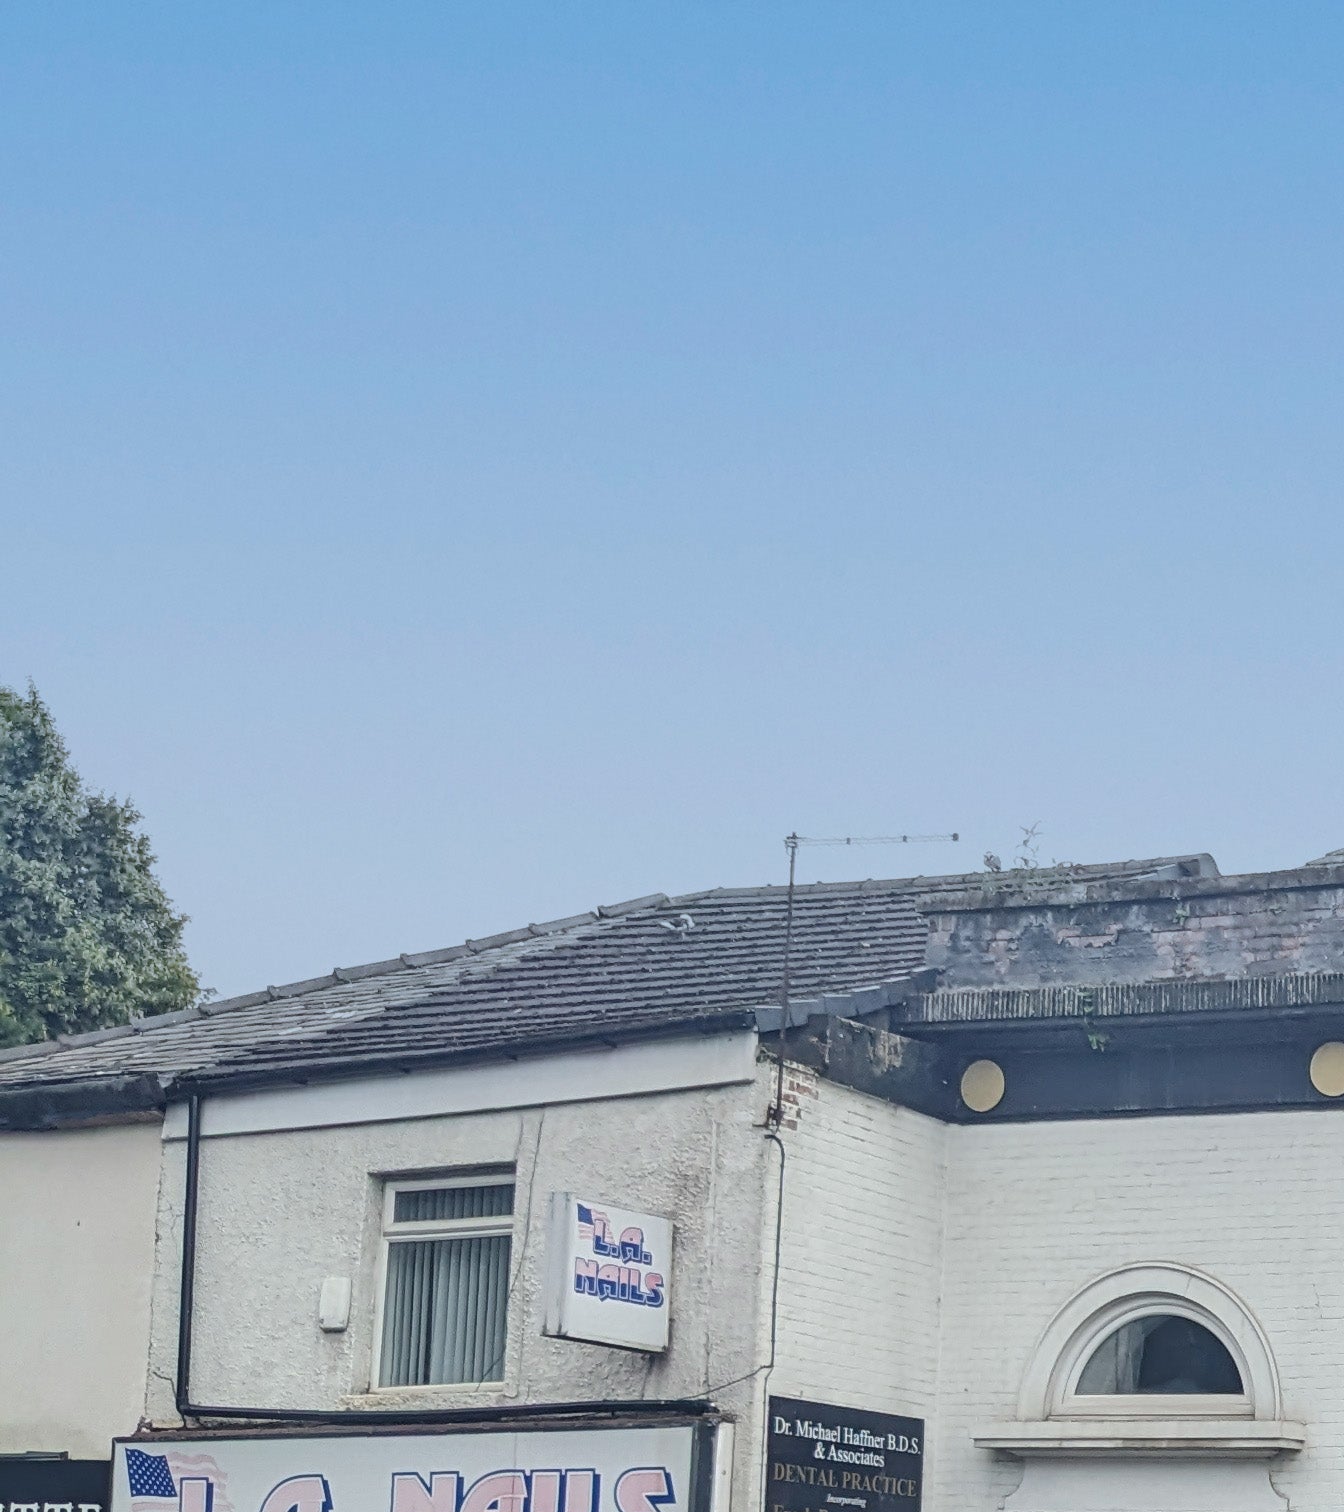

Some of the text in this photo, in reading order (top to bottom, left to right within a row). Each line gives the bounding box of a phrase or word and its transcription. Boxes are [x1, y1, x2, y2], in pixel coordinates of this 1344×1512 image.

[593, 1219, 652, 1265] L.A.
[574, 1257, 664, 1308] NAILS
[774, 1417, 920, 1454] Dr. Michael Haffner B.D.S.
[814, 1442, 885, 1467] & Associates
[774, 1463, 917, 1496] DENTAL PRACTICE
